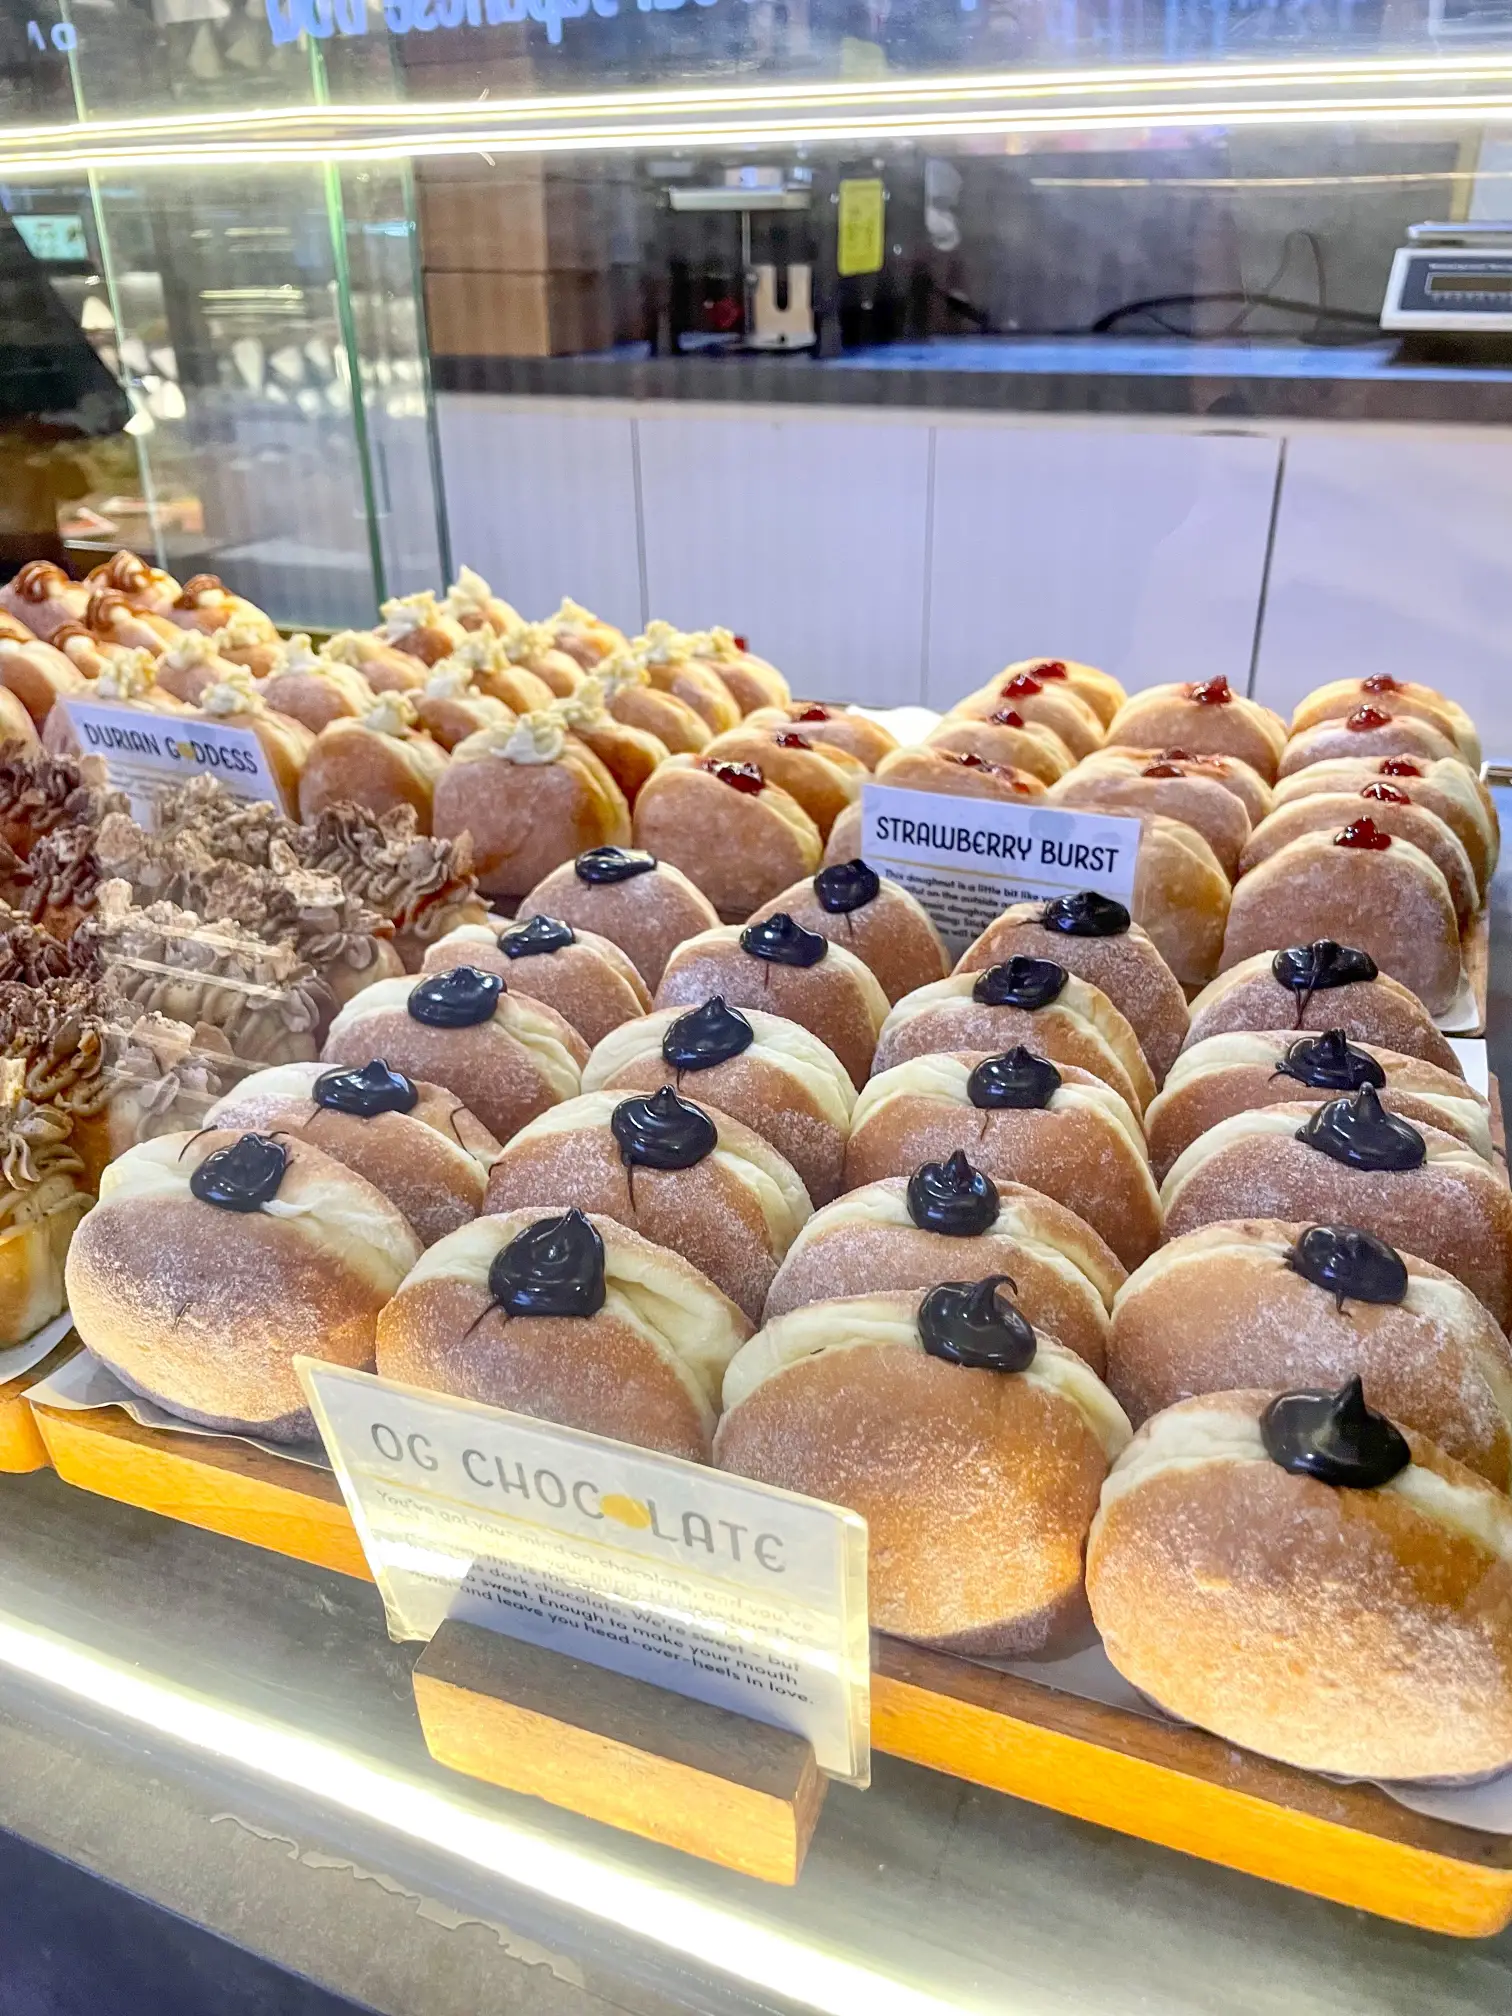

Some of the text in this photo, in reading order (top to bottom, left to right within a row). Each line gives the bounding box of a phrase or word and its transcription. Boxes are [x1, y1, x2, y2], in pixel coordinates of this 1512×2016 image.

[83, 722, 161, 756] DURIAN
[876, 816, 1119, 873] STRAWBERRY BURST
[884, 868, 904, 880] This
[906, 874, 956, 888] doughnut
[1003, 887, 1018, 897] bit
[370, 1422, 786, 1573] OG CHOCOLATE
[470, 1519, 514, 1537] your
[517, 1533, 564, 1555] mind
[571, 1549, 595, 1564] on
[460, 1585, 493, 1601] and
[497, 1592, 544, 1618] leave
[548, 1611, 580, 1629] you
[583, 1621, 742, 1682] head-over-heels
[745, 1671, 764, 1689] in
[768, 1681, 815, 1706] love.
[481, 1578, 534, 1601] sweet.
[538, 1593, 605, 1625] Enough
[609, 1618, 628, 1631] to
[633, 1626, 684, 1650] make
[689, 1644, 732, 1666] your
[735, 1659, 799, 1687] mouth
[489, 1567, 531, 1589] dark
[535, 1581, 628, 1618] chocolate.
[631, 1608, 687, 1637] We're
[691, 1632, 745, 1656] sweet
[768, 1653, 801, 1673] but
